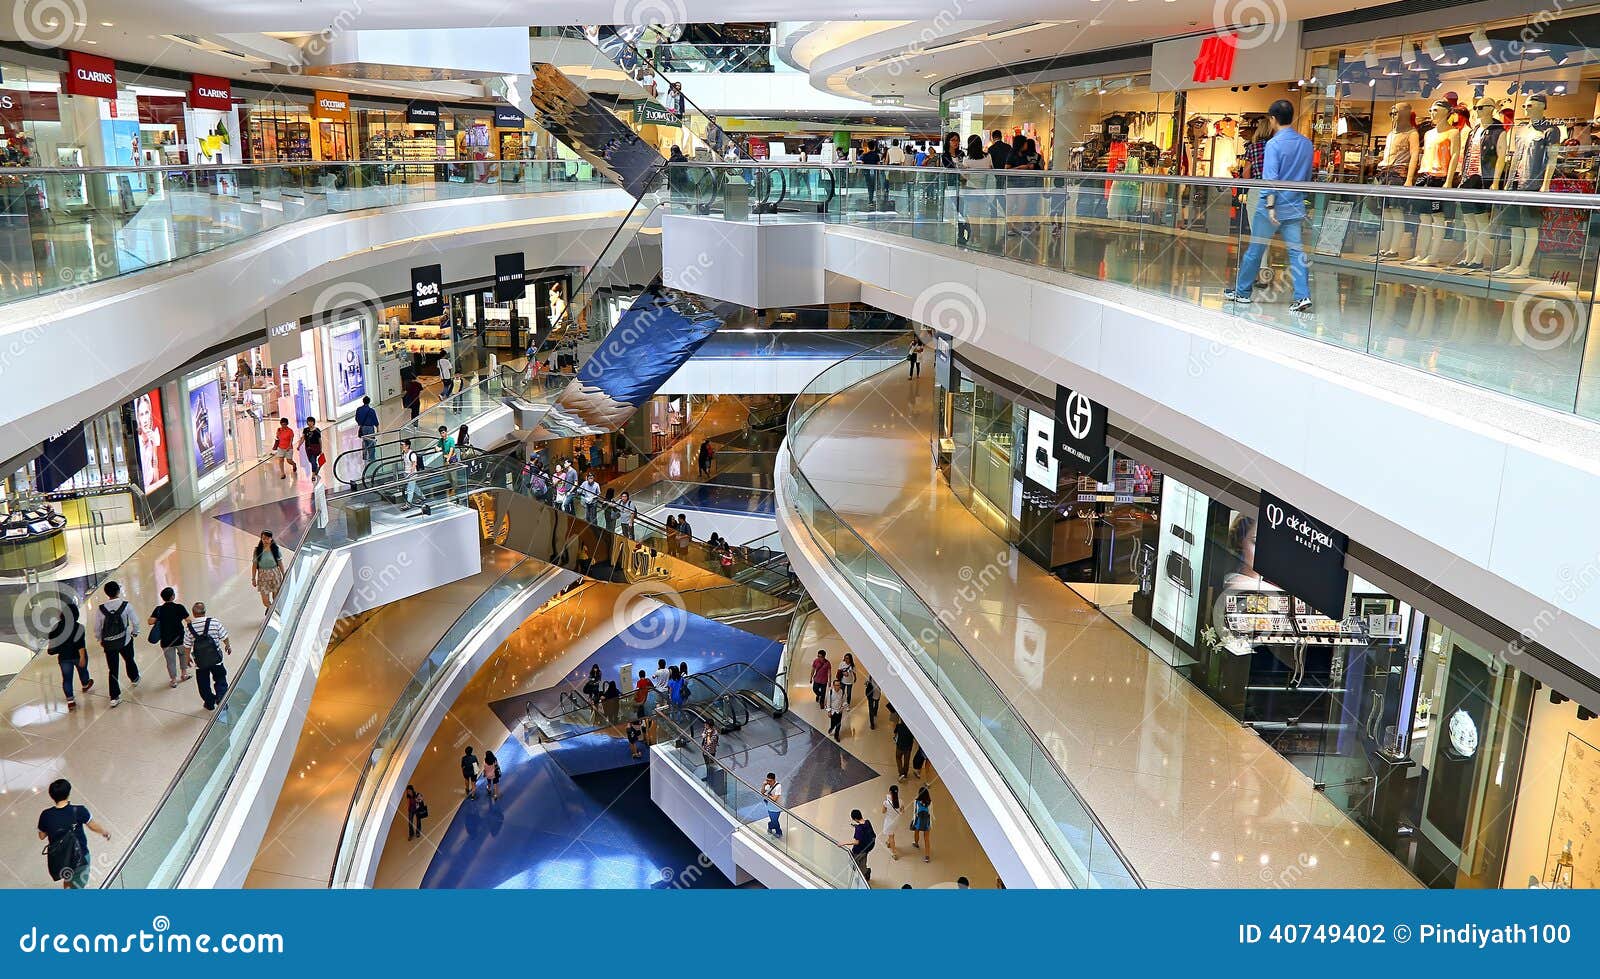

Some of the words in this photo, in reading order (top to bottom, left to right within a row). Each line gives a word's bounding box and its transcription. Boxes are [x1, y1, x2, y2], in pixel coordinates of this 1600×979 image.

[77, 69, 113, 84] CLARINS
[198, 87, 229, 99] CLARINS
[1310, 529, 1333, 549] peau
